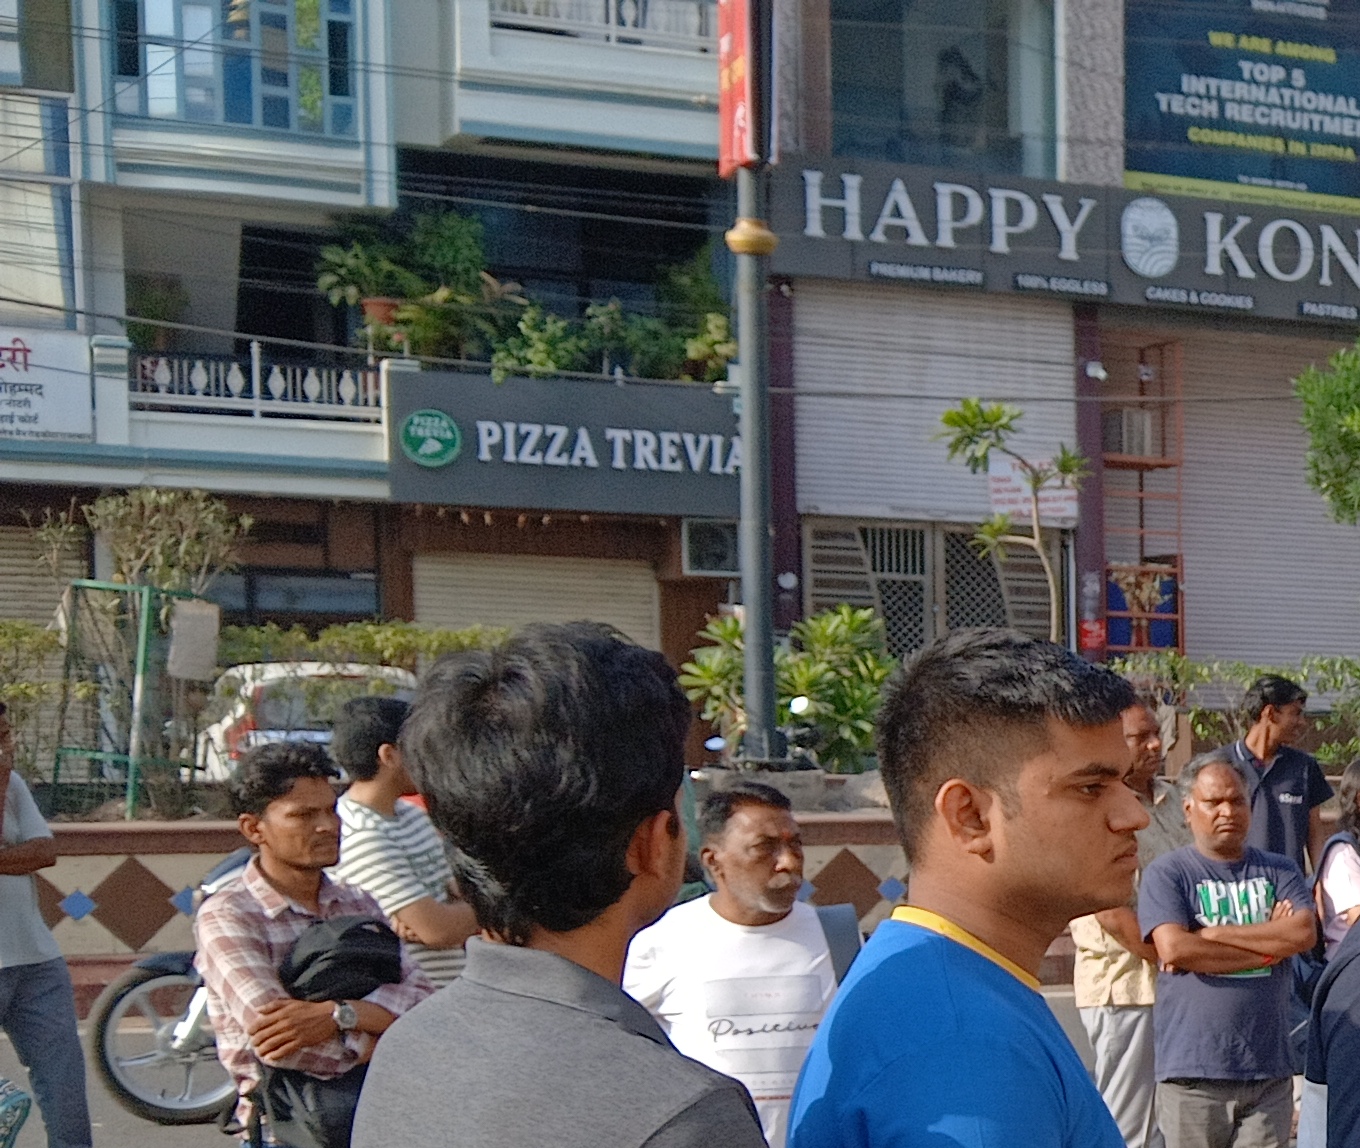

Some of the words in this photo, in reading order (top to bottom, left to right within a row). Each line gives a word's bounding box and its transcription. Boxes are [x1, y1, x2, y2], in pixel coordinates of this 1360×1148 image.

[1238, 60, 1286, 83] TOP
[1291, 67, 1306, 88] 5
[1155, 92, 1219, 119] TECH
[1187, 126, 1286, 154] COMPANIES
[1288, 140, 1307, 156] IN
[1310, 142, 1357, 162] INDIA
[802, 169, 1098, 261] HAPPY
[869, 261, 931, 280] PREMIUM
[932, 266, 983, 285] BAKERY
[1050, 276, 1108, 296] EGGLESS
[1145, 286, 1187, 303] CAKES
[1200, 292, 1254, 309] COOKIES
[1302, 301, 1358, 320] PASTRIES
[476, 420, 599, 468] PIZZA
